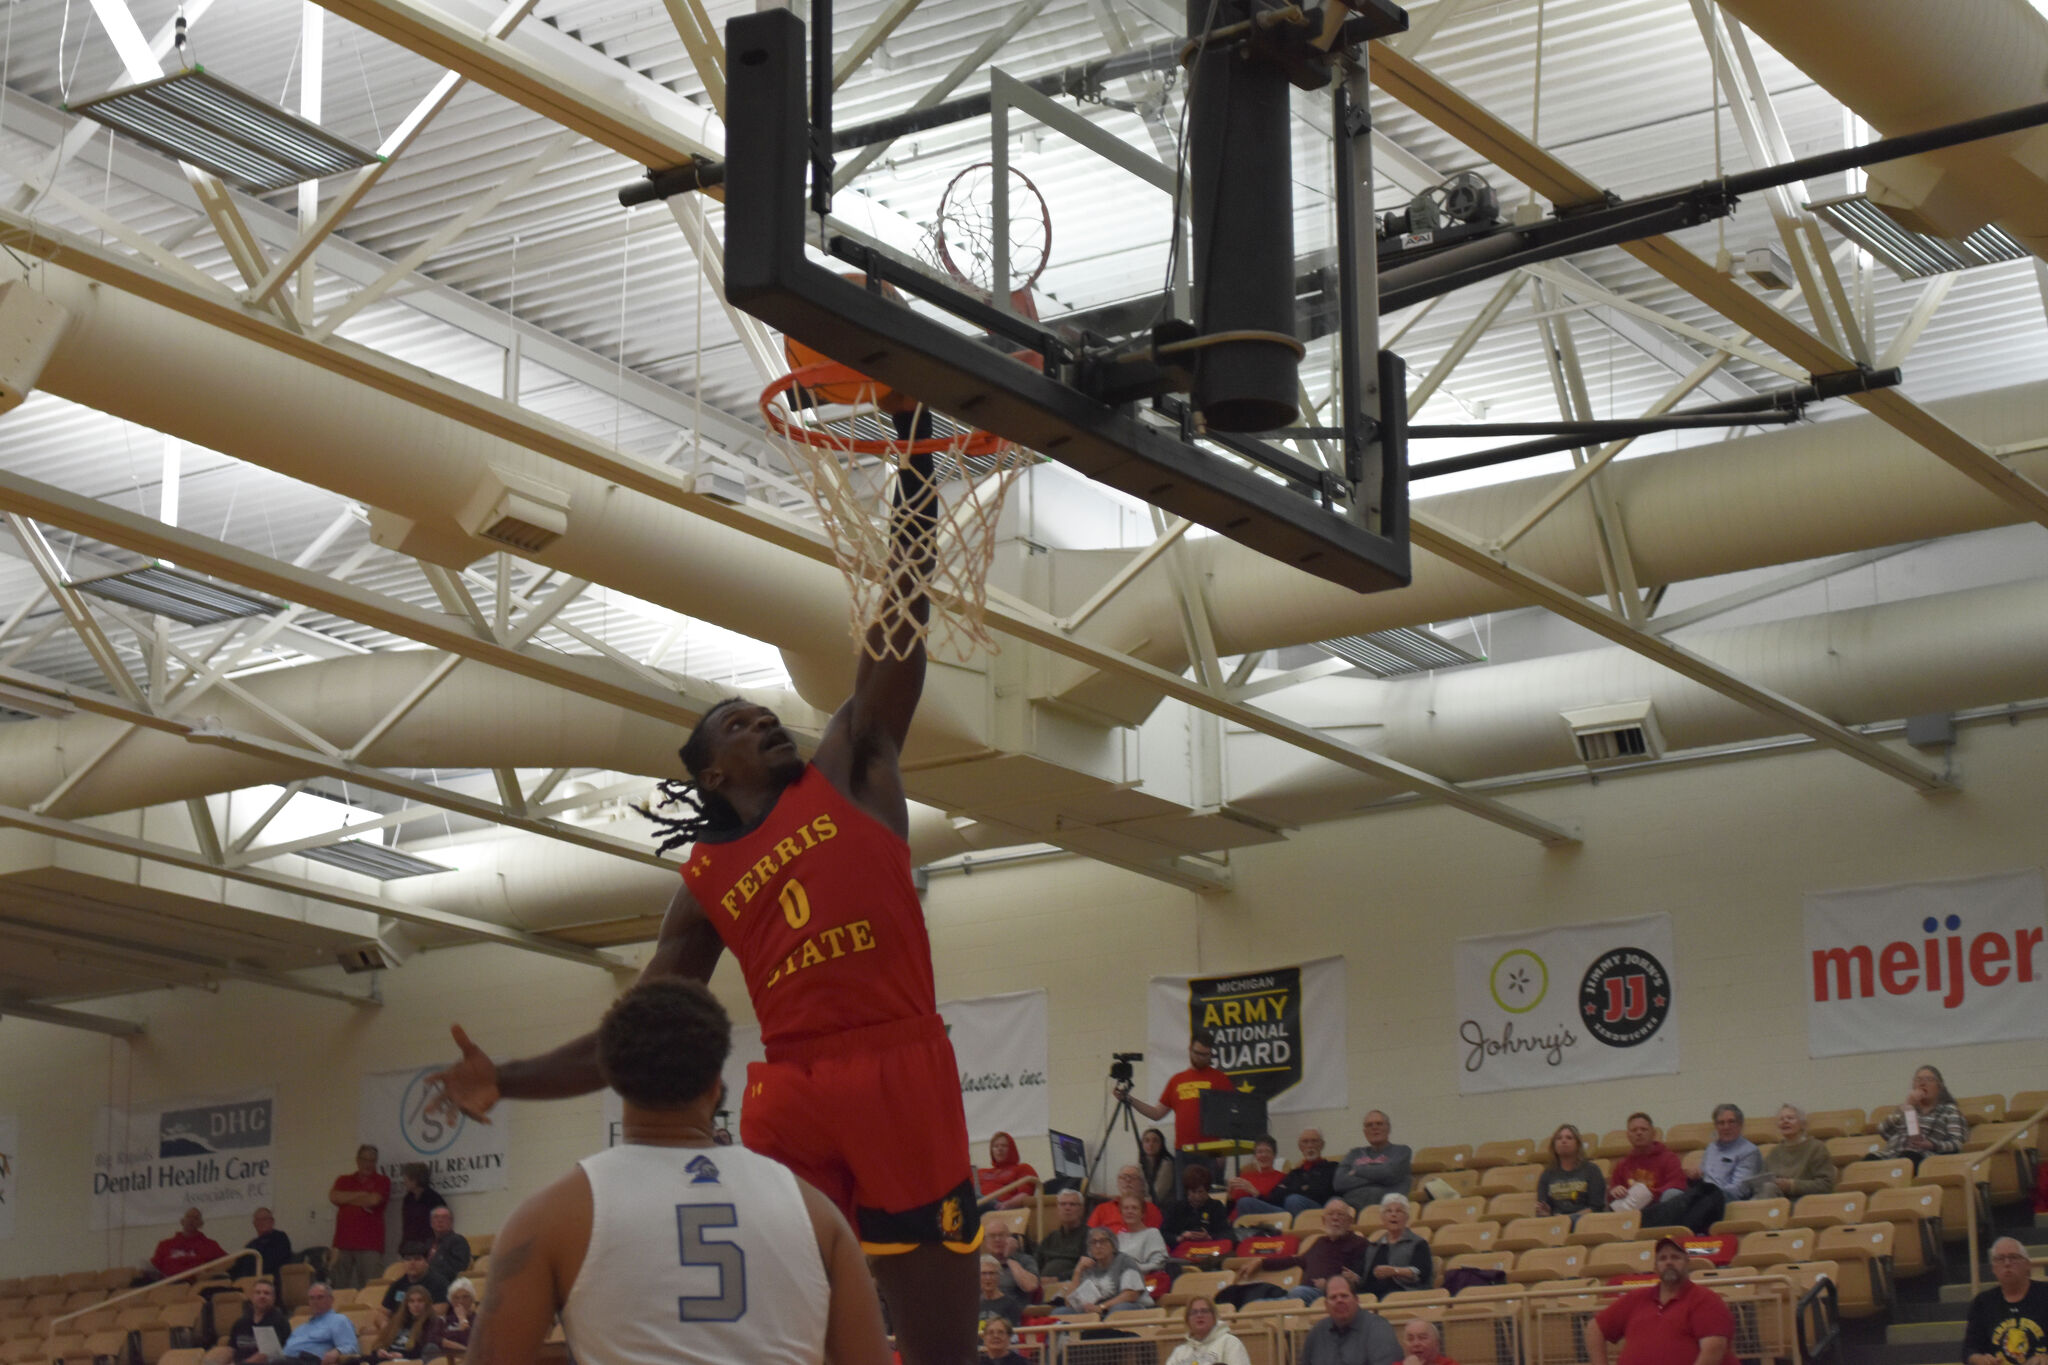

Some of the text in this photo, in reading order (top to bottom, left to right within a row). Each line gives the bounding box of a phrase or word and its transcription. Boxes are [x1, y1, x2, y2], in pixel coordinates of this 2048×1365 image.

[721, 814, 838, 920] FERRIS
[778, 878, 810, 929] 0
[1585, 953, 1664, 994] JIMMY JOHN'S
[1812, 914, 2043, 1009] meijer
[1216, 976, 1275, 993] MICHIGAN
[1603, 974, 1648, 1023] JJ
[1203, 995, 1288, 1028] ARMY
[1209, 1022, 1289, 1044] ATIONAL
[1460, 1020, 1577, 1072] Johnny's
[211, 1107, 265, 1136] DHC
[93, 1156, 270, 1195] Dental Health Care
[447, 1153, 504, 1173] REALTY
[675, 1203, 748, 1323] 5
